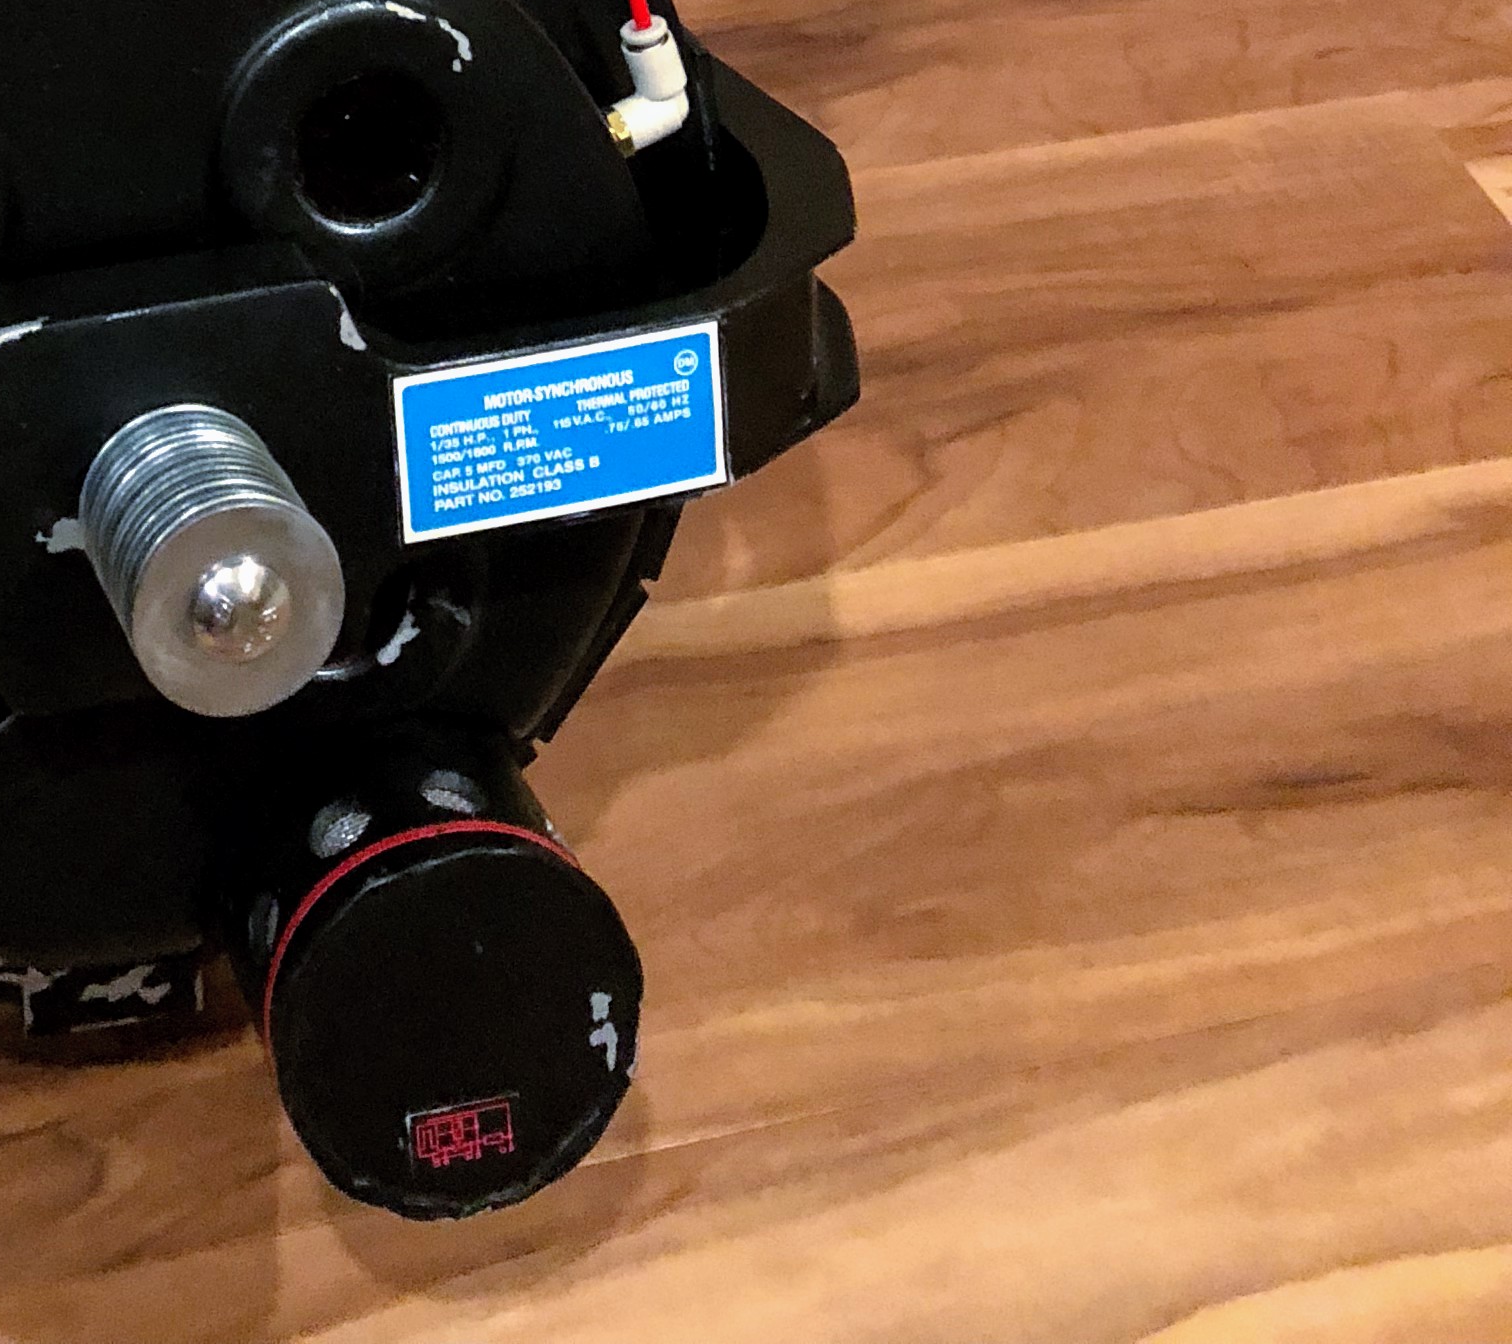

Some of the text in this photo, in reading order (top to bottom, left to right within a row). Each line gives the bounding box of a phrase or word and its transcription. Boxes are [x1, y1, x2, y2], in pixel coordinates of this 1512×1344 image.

[576, 379, 690, 412] THERMAL PROTECTED
[429, 409, 531, 438] CONTINUOUS DUTY
[654, 407, 691, 424] AMPS
[433, 455, 600, 497] INSULATION CLASS B
[476, 459, 506, 474] MFD
[544, 447, 573, 461] VAC
[434, 478, 562, 512] PART NO. 252193
